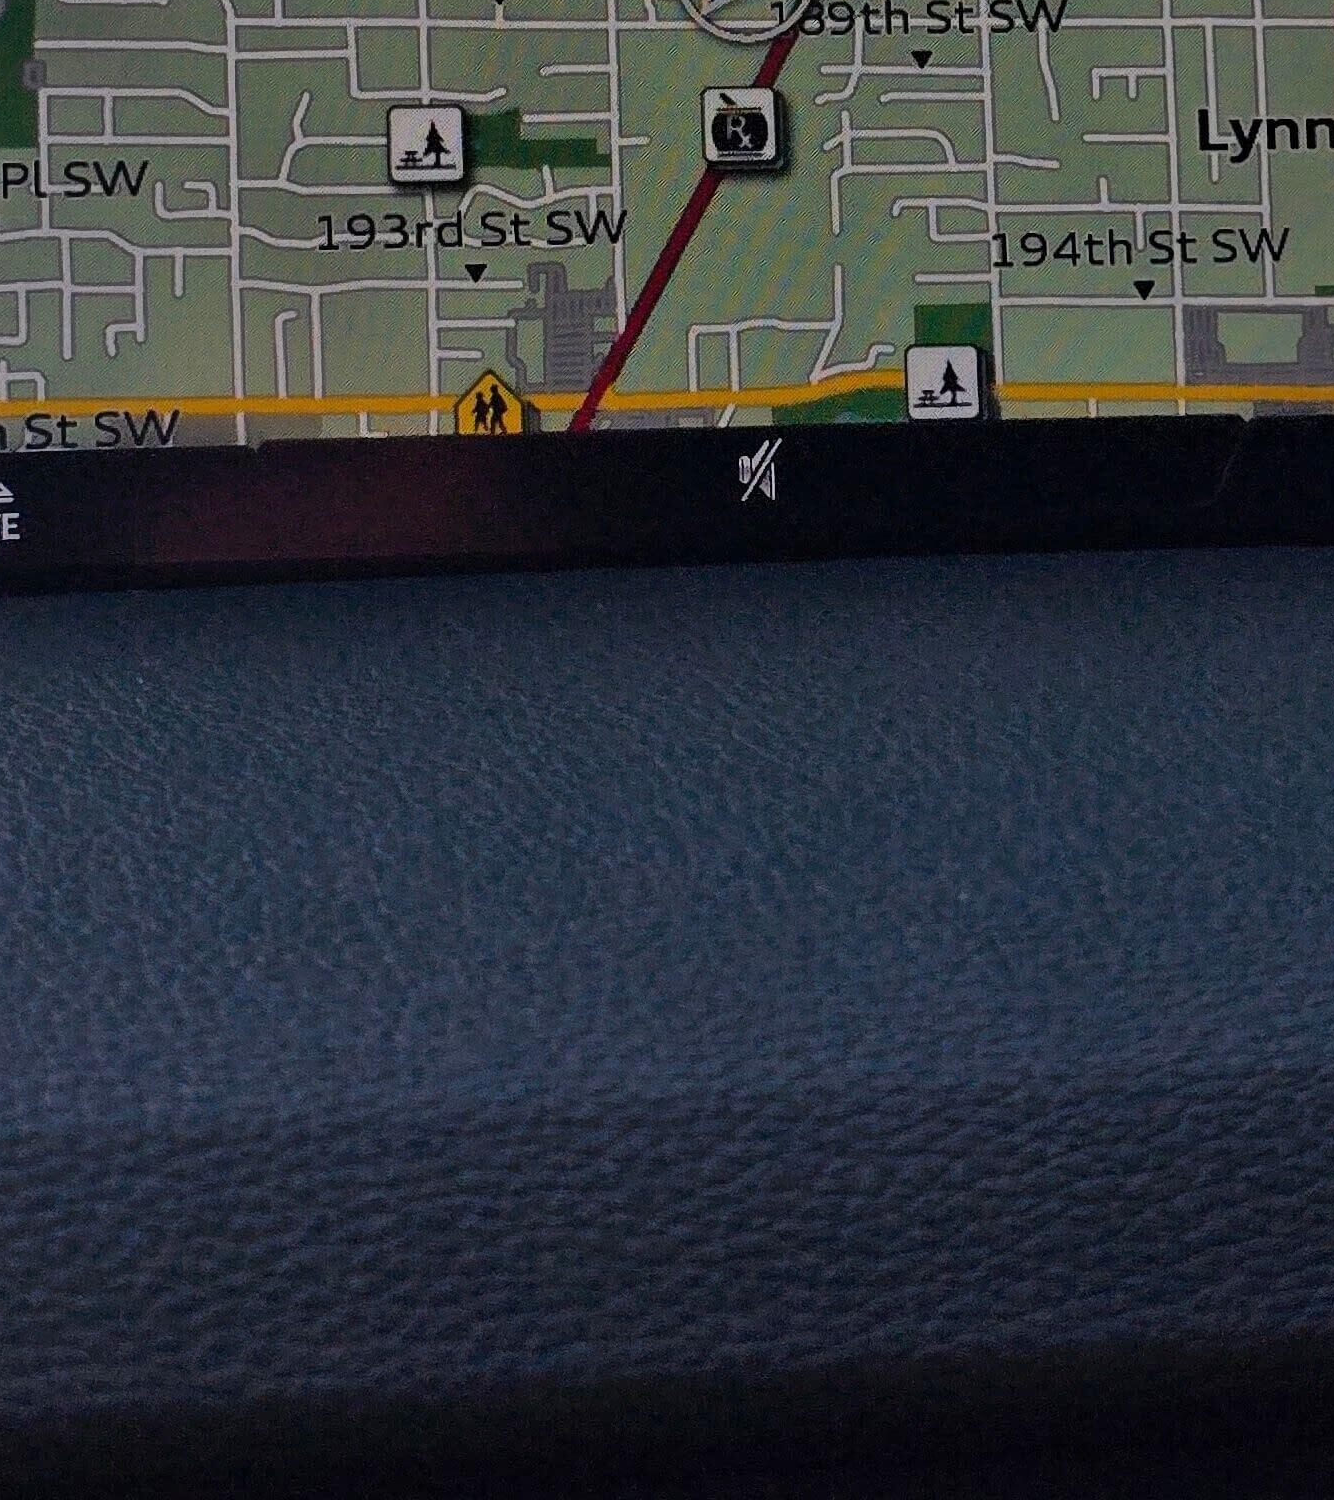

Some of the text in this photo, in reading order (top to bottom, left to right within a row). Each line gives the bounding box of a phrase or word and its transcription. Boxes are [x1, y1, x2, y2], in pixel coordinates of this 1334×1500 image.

[770, 0, 1067, 36] 189th St SW
[4, 162, 47, 199] Pl
[64, 161, 149, 199] SW
[317, 210, 627, 250] 193rd St SW
[993, 227, 1289, 267] 194th St SW
[26, 414, 78, 449] St
[95, 410, 180, 448] SW
